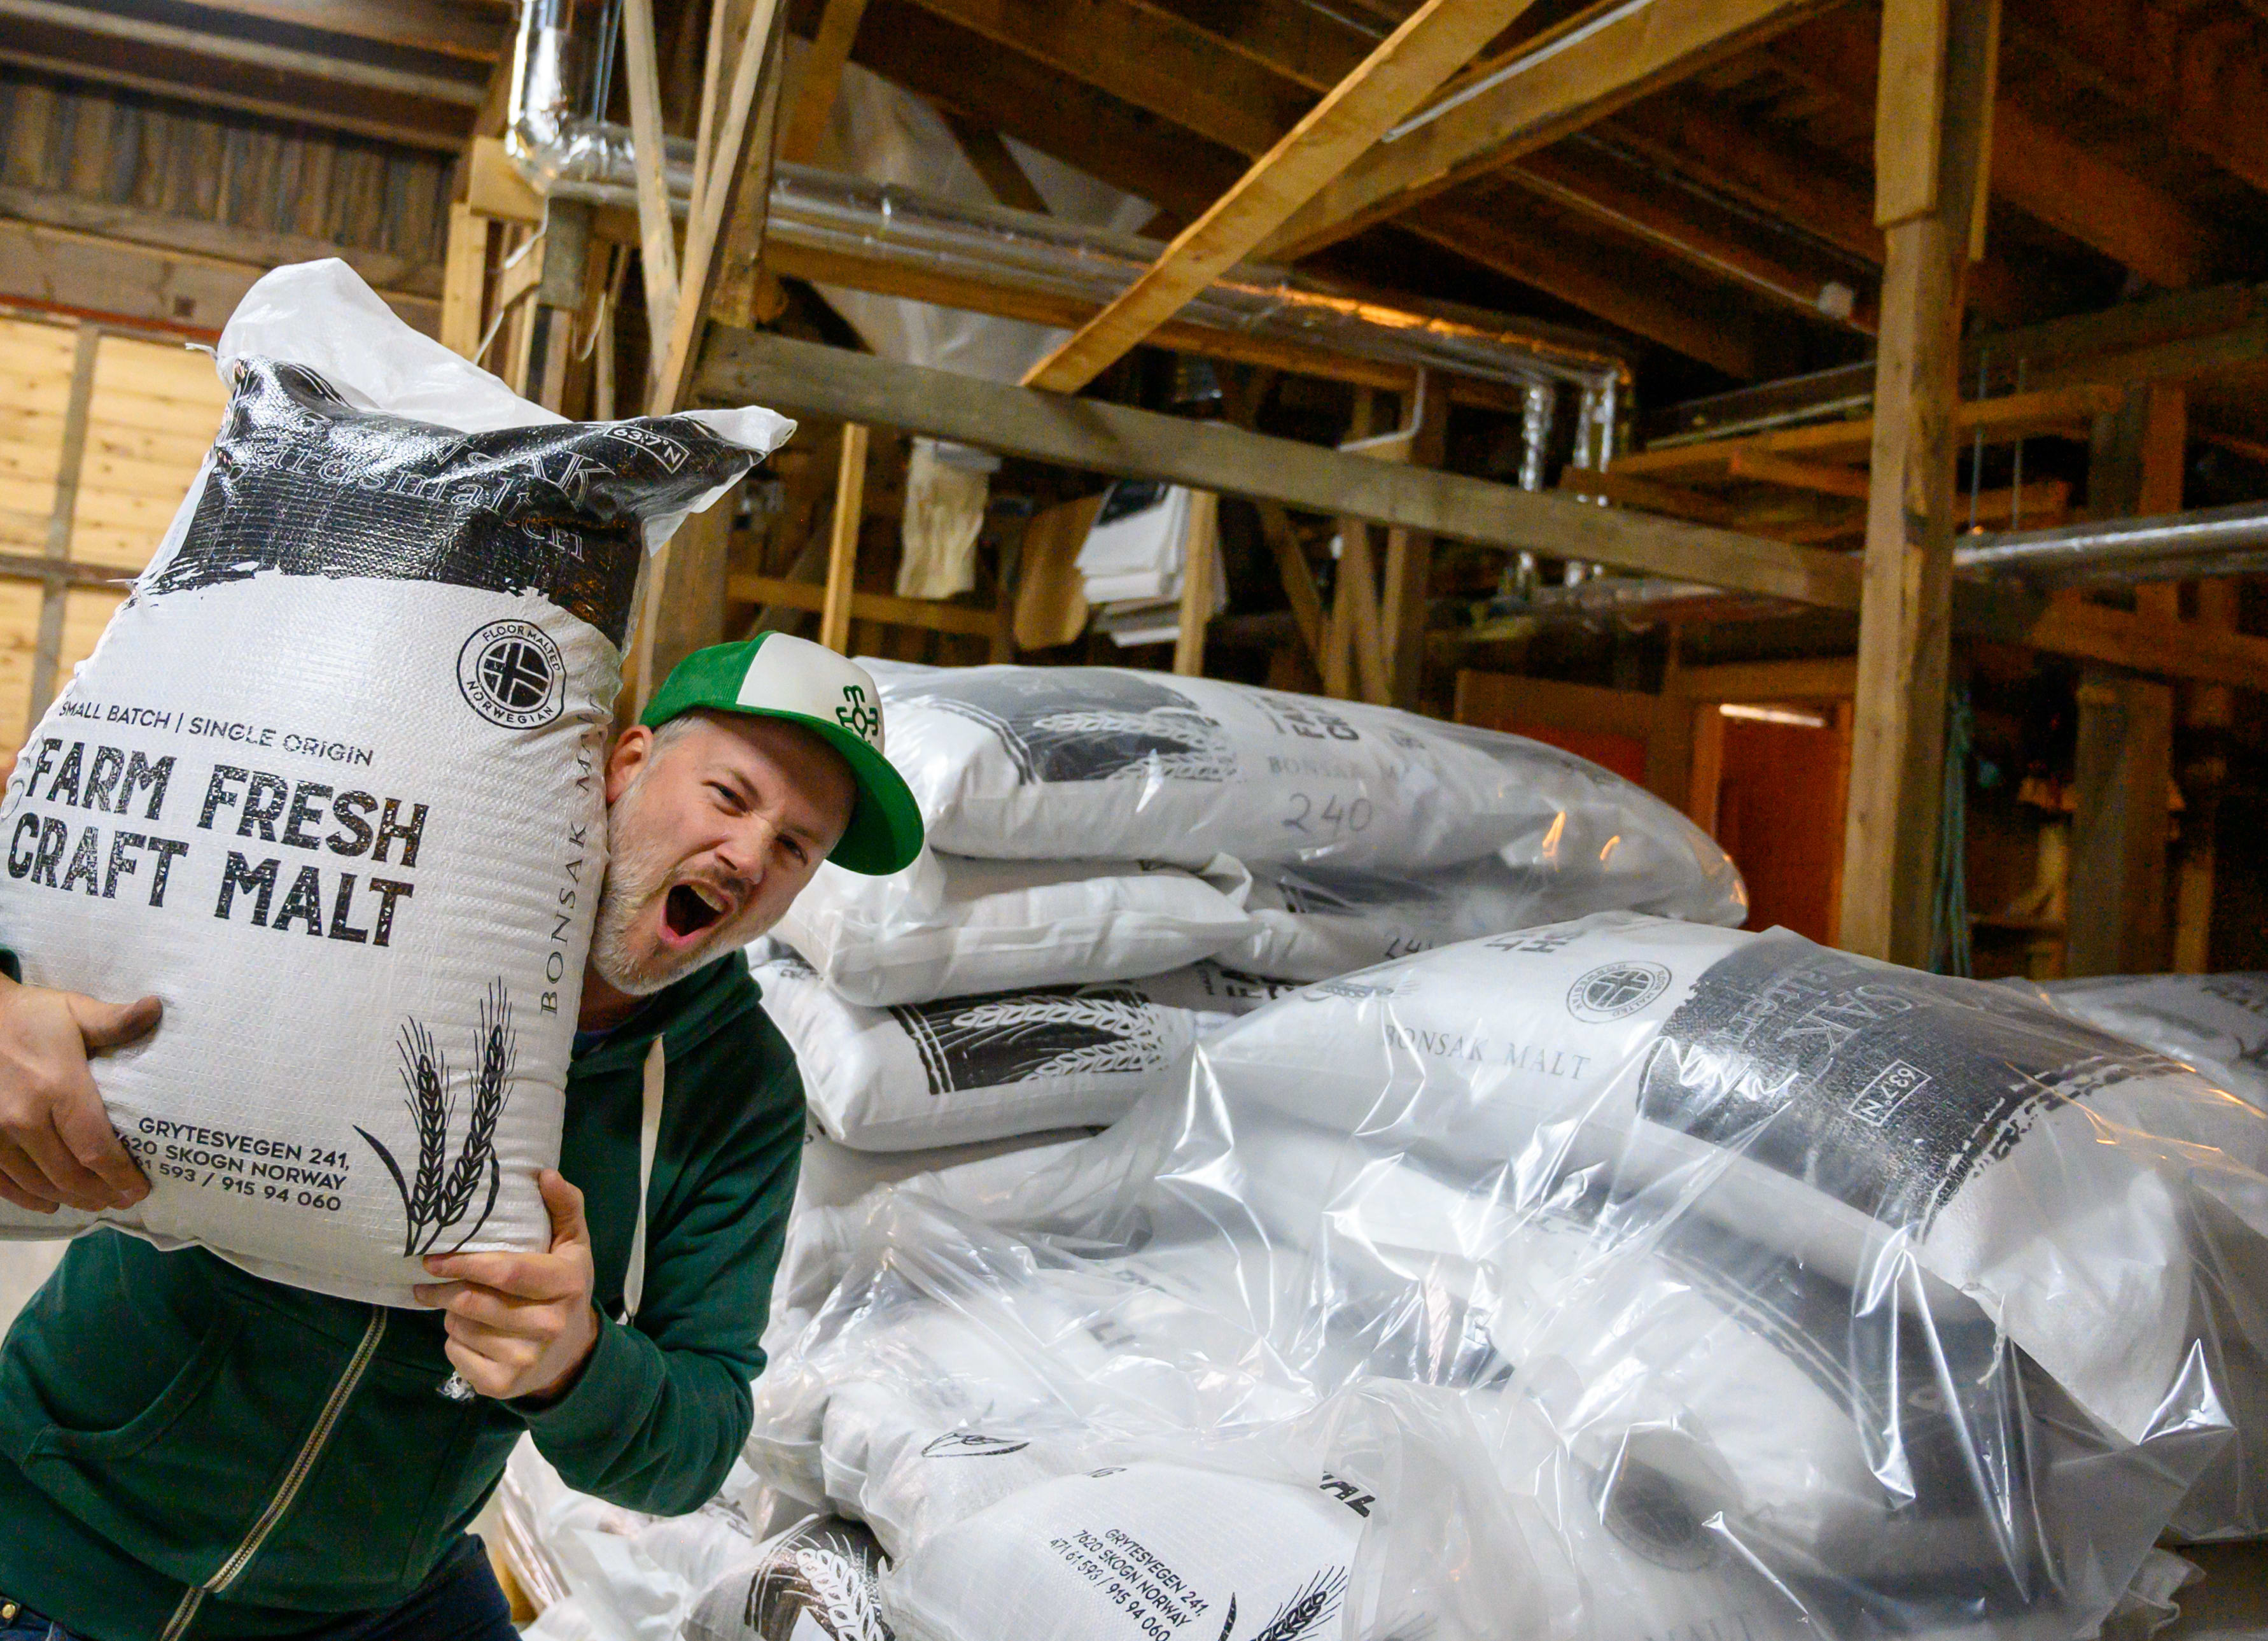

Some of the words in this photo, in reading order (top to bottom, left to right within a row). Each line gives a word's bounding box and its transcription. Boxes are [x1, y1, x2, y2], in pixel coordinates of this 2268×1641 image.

[482, 624, 524, 642] FLOOR
[528, 630, 561, 671] MALTED
[466, 680, 554, 724] NORWEGIAN
[59, 701, 101, 720] SMALL
[107, 705, 171, 729] BATCH
[189, 717, 276, 747] SINGLE
[283, 734, 373, 766] ORIGIN
[25, 738, 178, 820] FARM
[196, 764, 429, 868] FRESH
[1281, 792, 1374, 833] 240
[8, 812, 190, 908] CRAFT
[214, 851, 414, 947] MALT
[540, 821, 586, 1015] BONSAK
[1382, 1024, 1488, 1062] BONSAK
[1504, 1042, 1591, 1080] MALT
[139, 1117, 302, 1161] GRYTESVEGEN
[309, 1148, 349, 1171] 241,
[165, 1144, 244, 1173] SKOGN
[251, 1161, 347, 1190] NORWAY
[159, 1162, 196, 1182] 593
[222, 1176, 255, 1195] 915
[264, 1185, 289, 1202] 94
[297, 1191, 342, 1211] 060
[1065, 1550, 1084, 1565] 61
[1077, 1560, 1104, 1581] 593
[1105, 1582, 1131, 1604] 915
[1125, 1600, 1146, 1620] 94
[1141, 1616, 1171, 1641] 060
[1072, 1529, 1104, 1553] 7620
[1098, 1549, 1144, 1584] SKOGN
[1136, 1579, 1193, 1628] NORWAY
[1105, 1528, 1187, 1594] GRYTESVEGEN
[1180, 1591, 1210, 1617] 241,
